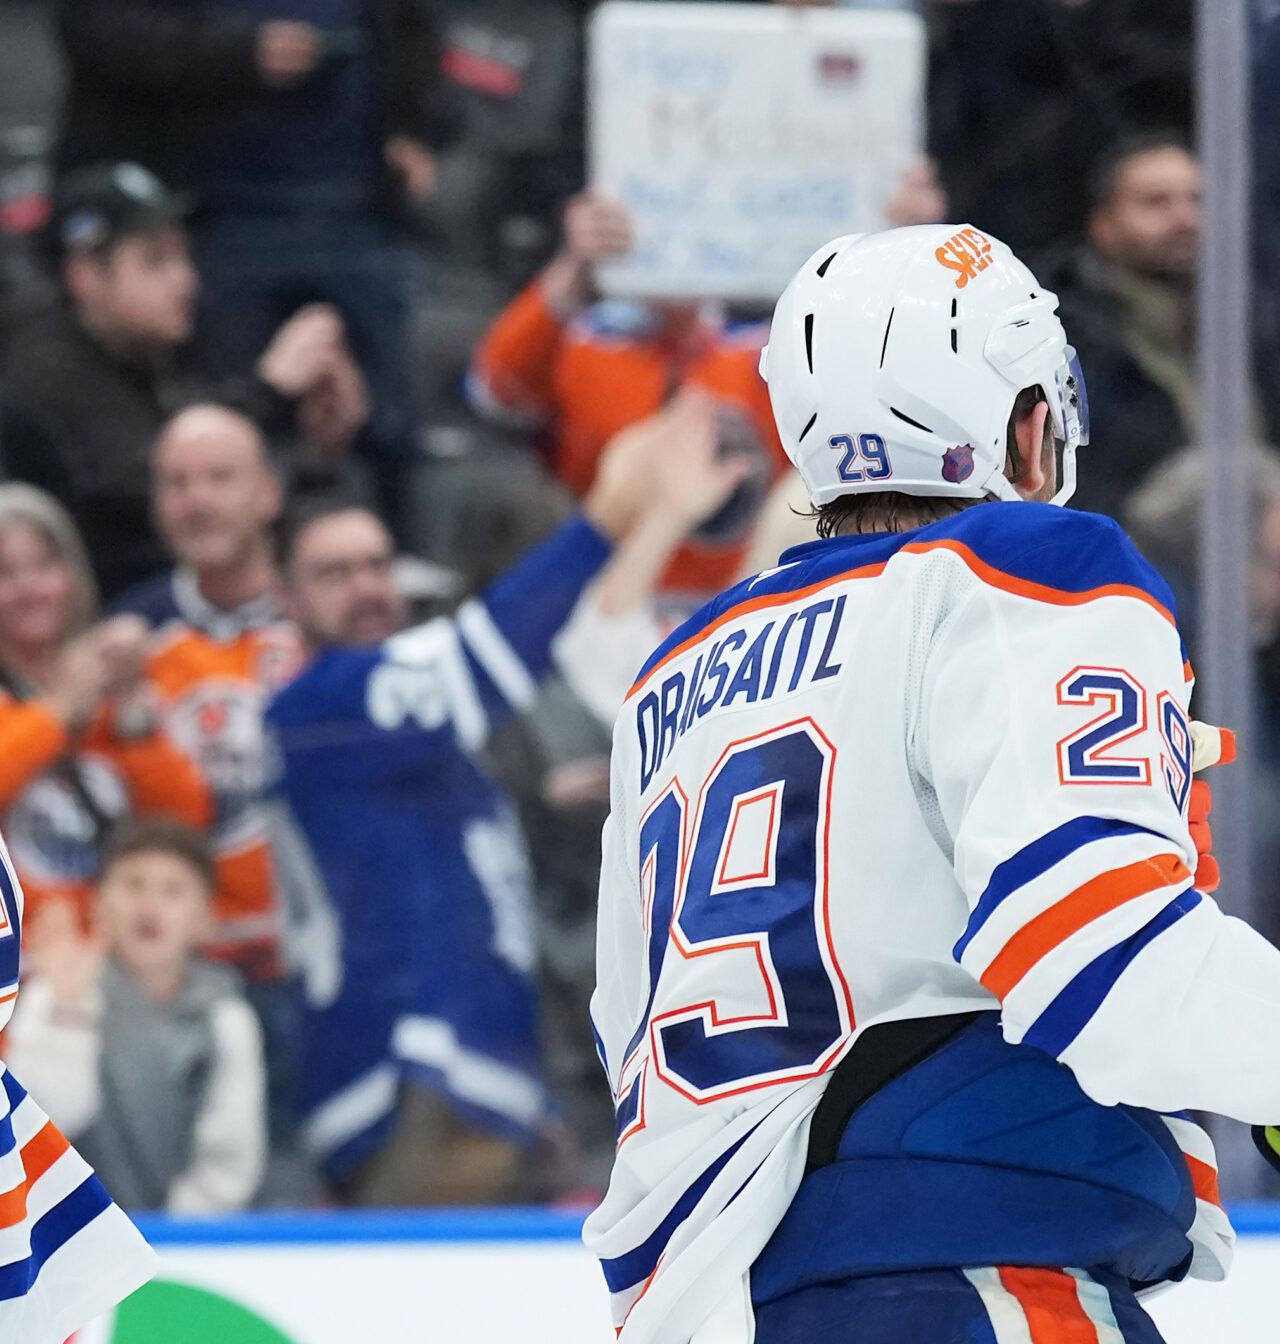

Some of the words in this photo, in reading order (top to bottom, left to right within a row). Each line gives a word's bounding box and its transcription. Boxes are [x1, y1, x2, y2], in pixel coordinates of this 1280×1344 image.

[935, 228, 994, 288] SKIP
[828, 432, 893, 484] 29
[1056, 665, 1191, 818] 29
